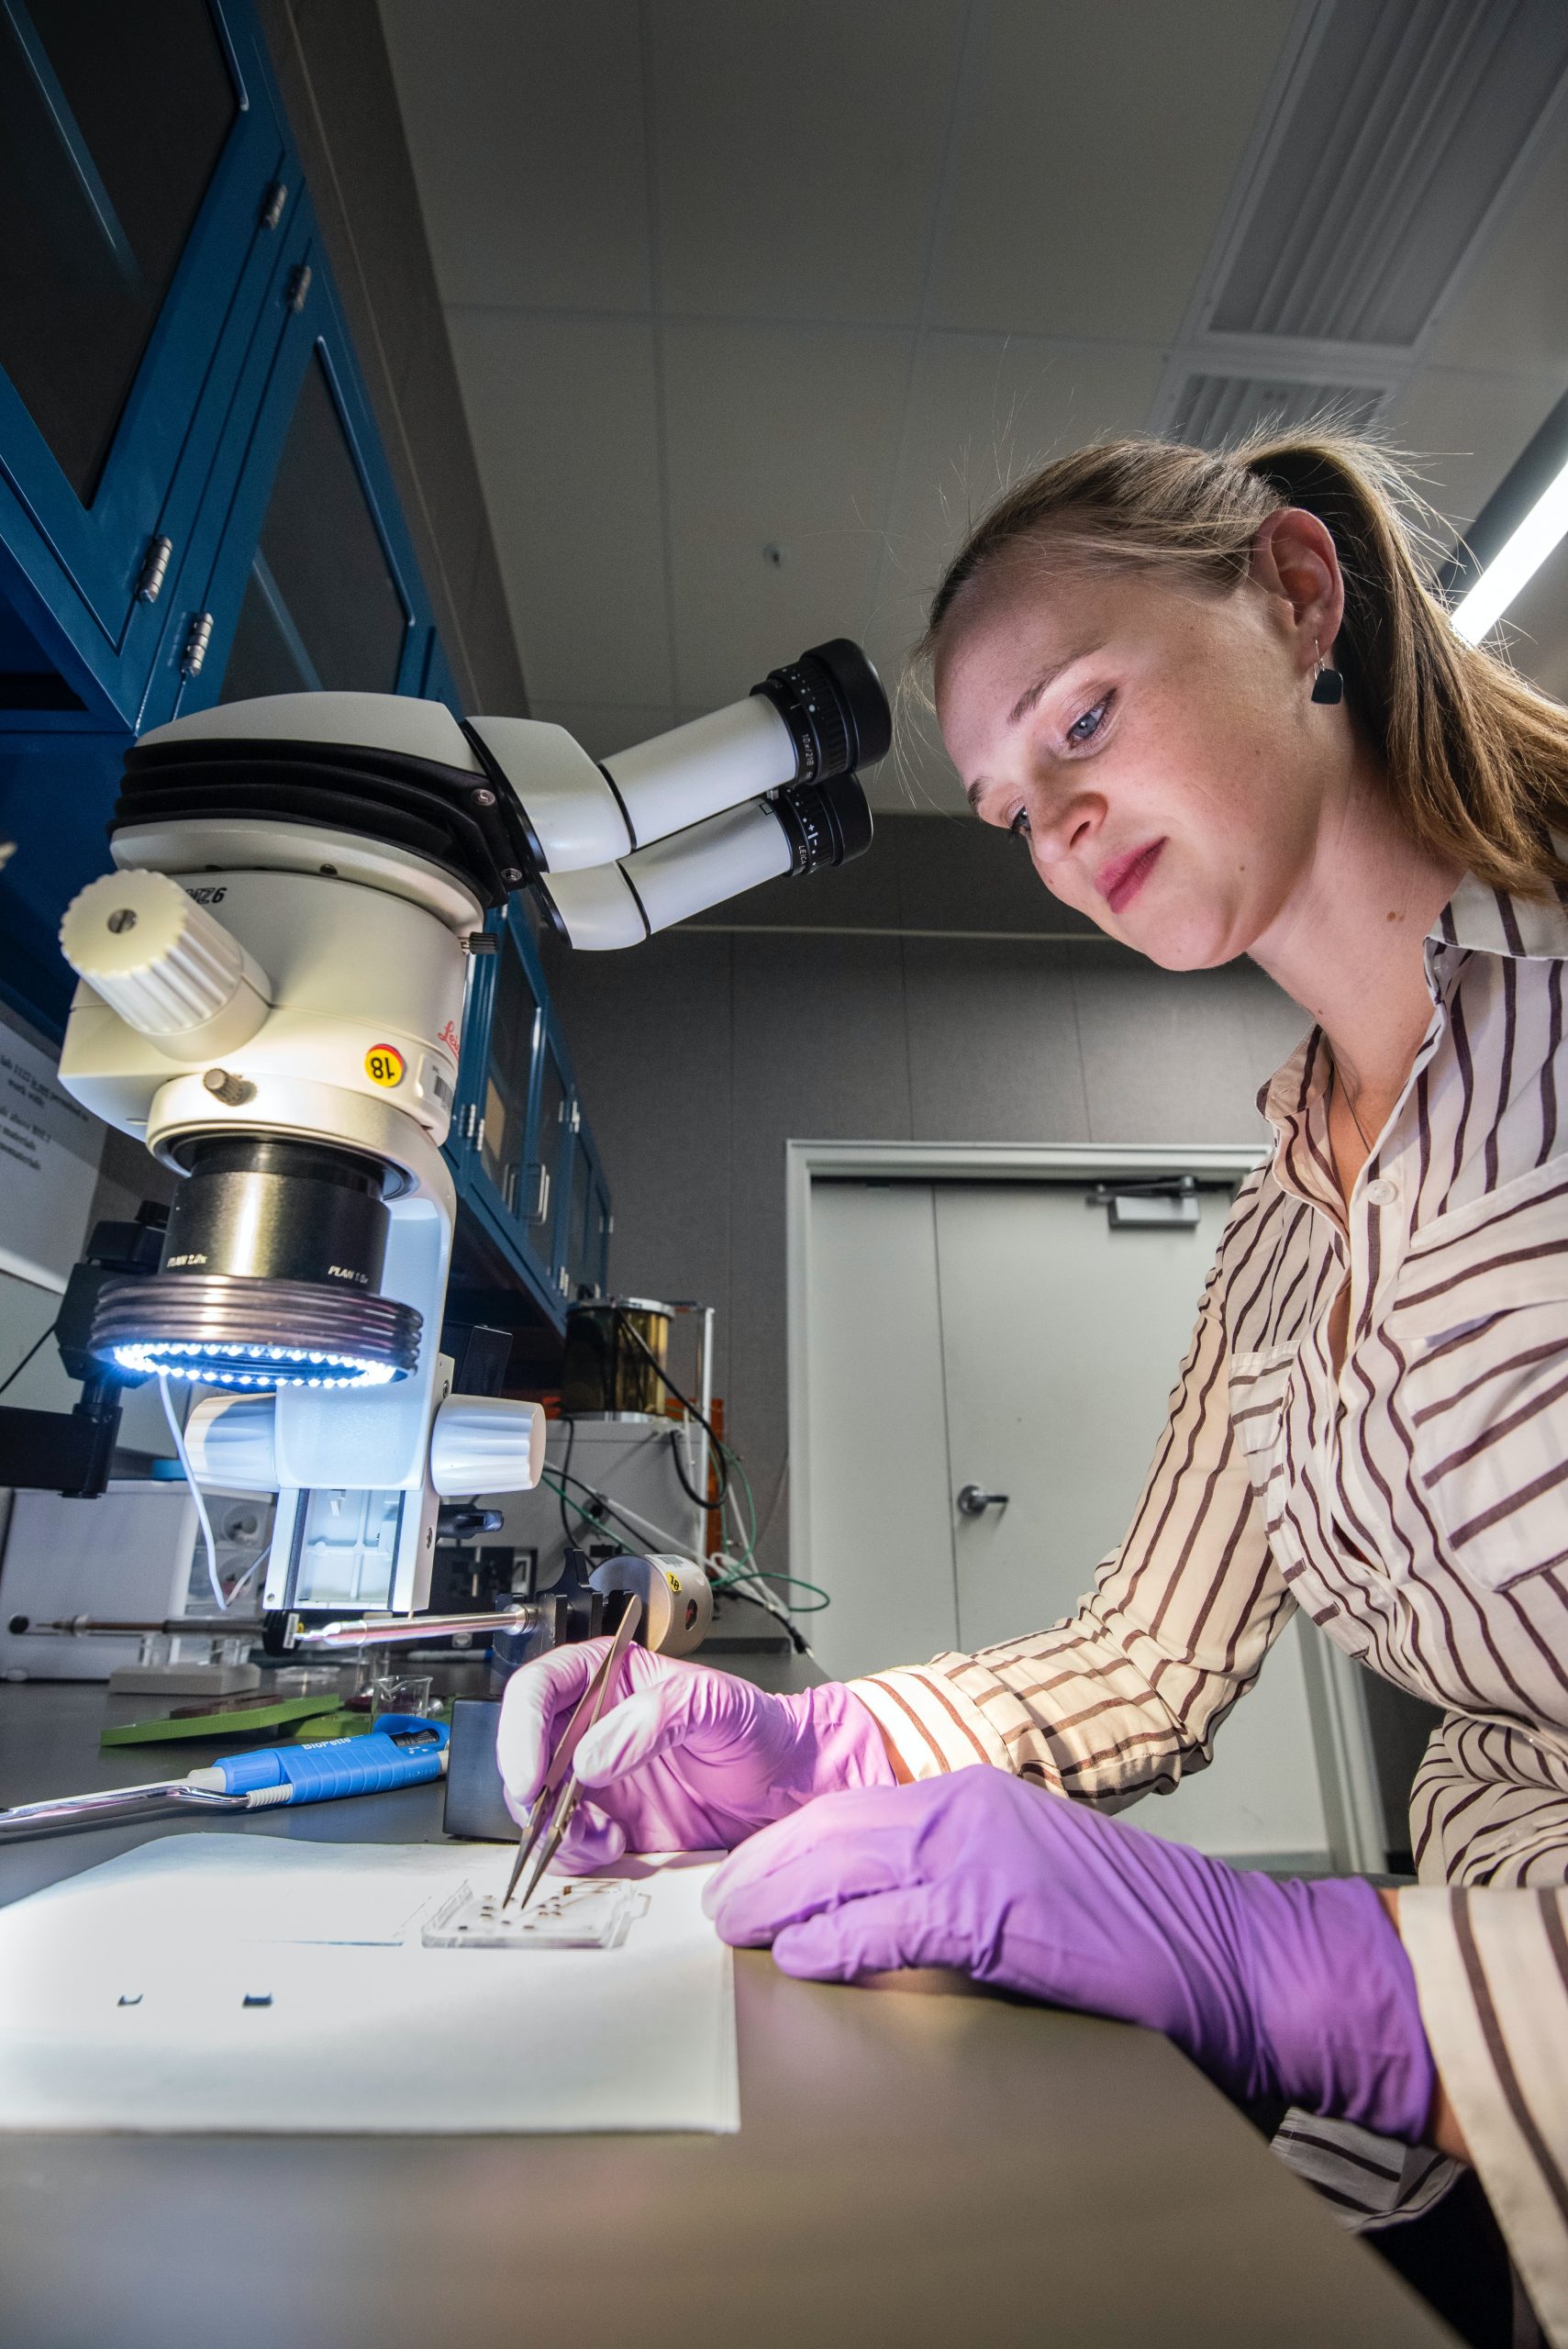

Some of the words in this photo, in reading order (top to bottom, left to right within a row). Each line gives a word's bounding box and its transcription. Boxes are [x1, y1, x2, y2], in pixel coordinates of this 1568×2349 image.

[798, 845, 807, 865] LEICA
[438, 1020, 460, 1058] Lei
[371, 1057, 395, 1080] 18
[328, 1265, 354, 1280] PLAN
[669, 1574, 680, 1591] 18
[302, 1737, 351, 1750] BioPette
